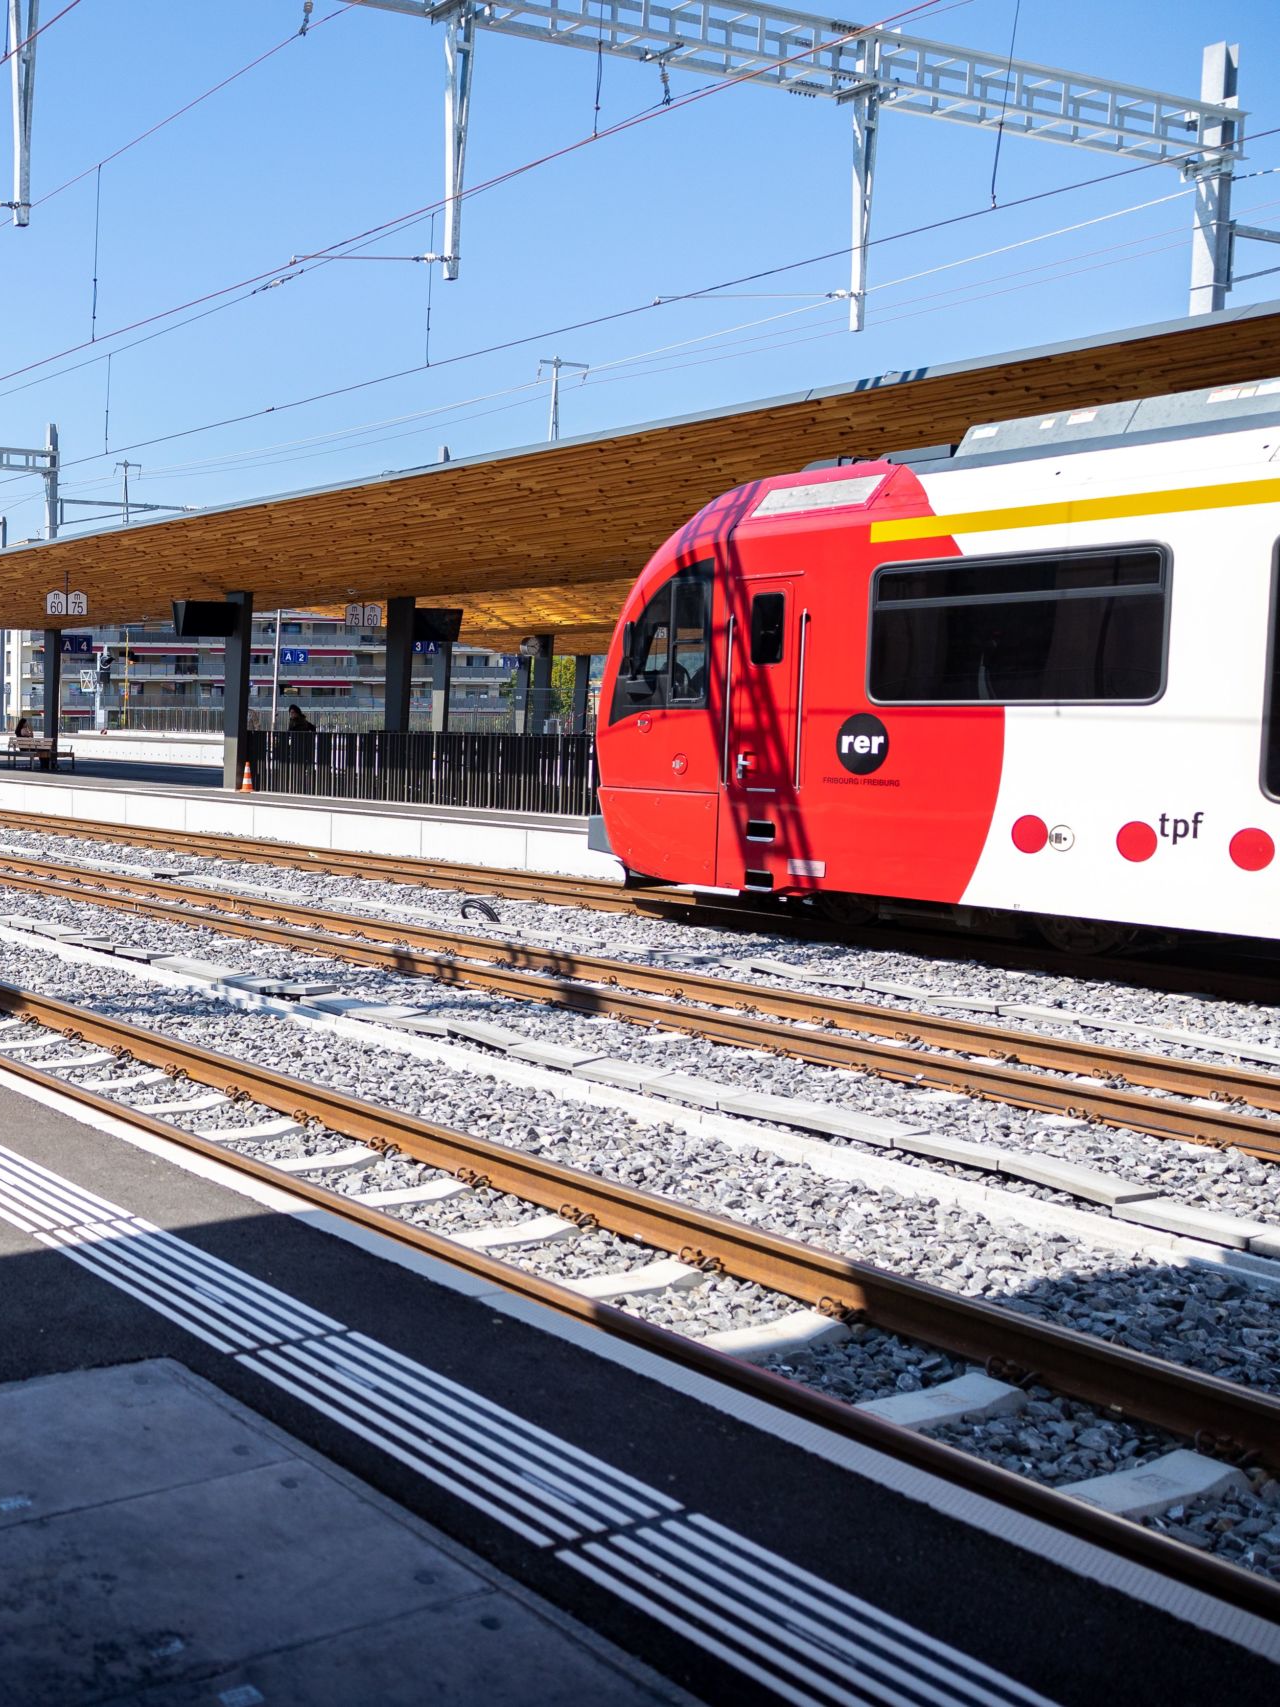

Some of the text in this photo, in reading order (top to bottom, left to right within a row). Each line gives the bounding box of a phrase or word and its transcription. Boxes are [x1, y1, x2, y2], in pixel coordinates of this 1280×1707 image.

[73, 593, 81, 601] m
[50, 601, 63, 614] 60
[71, 601, 84, 614] 75
[349, 613, 360, 626] 75
[367, 613, 379, 626] 60
[63, 640, 72, 651] A
[80, 641, 88, 651] 4
[415, 641, 422, 651] 3
[428, 642, 436, 651] A
[285, 652, 292, 661] A
[298, 653, 305, 662] 2
[841, 735, 885, 754] rer
[823, 777, 900, 787] FRIBOURG FREIBURG
[1159, 811, 1204, 845] tpf
